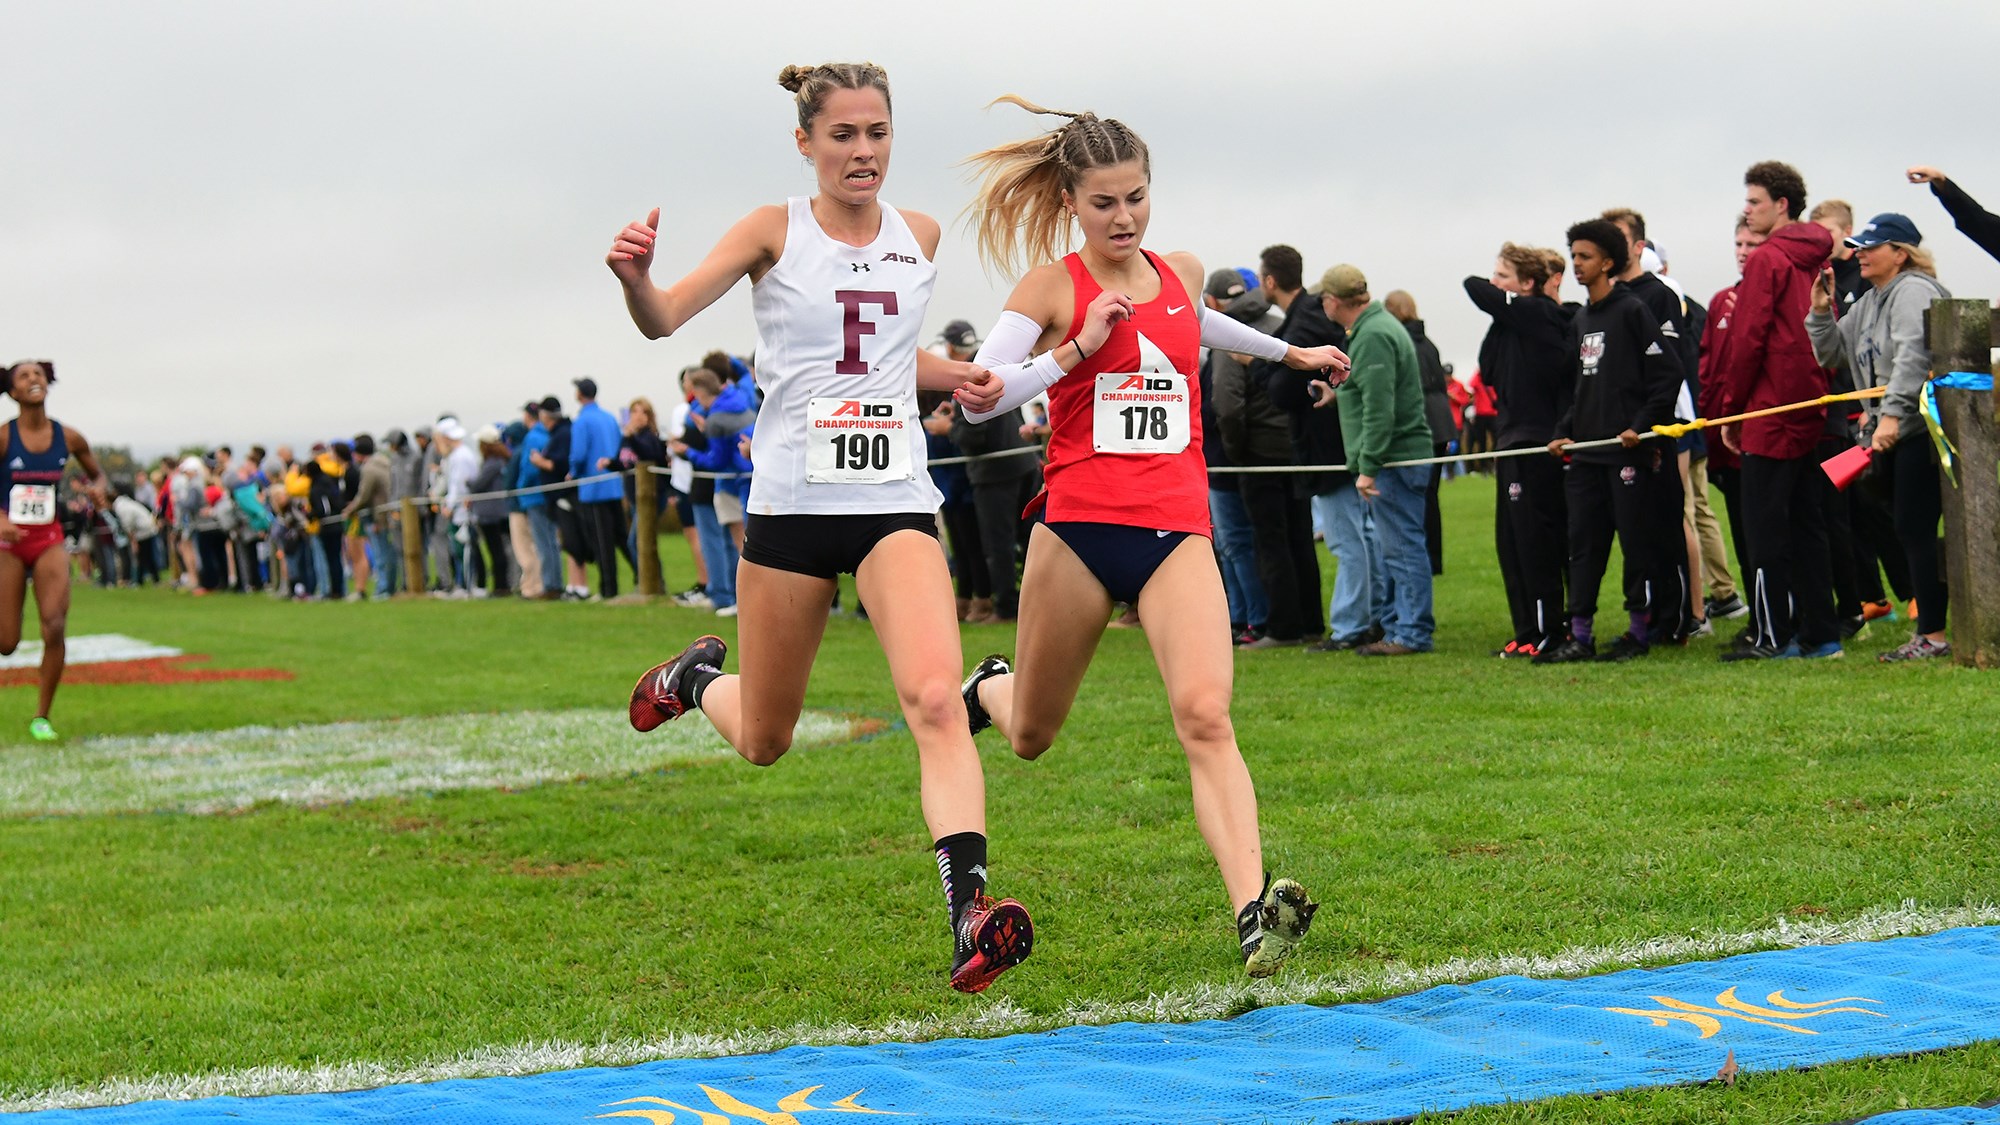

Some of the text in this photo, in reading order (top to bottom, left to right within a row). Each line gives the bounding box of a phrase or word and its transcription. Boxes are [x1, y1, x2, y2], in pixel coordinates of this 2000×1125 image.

[879, 252, 917, 265] A10
[835, 289, 899, 375] F
[1116, 375, 1173, 391] A10
[1101, 393, 1183, 403] CHAMPIONSHIPS
[833, 401, 893, 417] A10
[814, 419, 904, 430] CHAMPIONSHIPS
[1119, 406, 1169, 440] 178
[830, 433, 890, 470] 190
